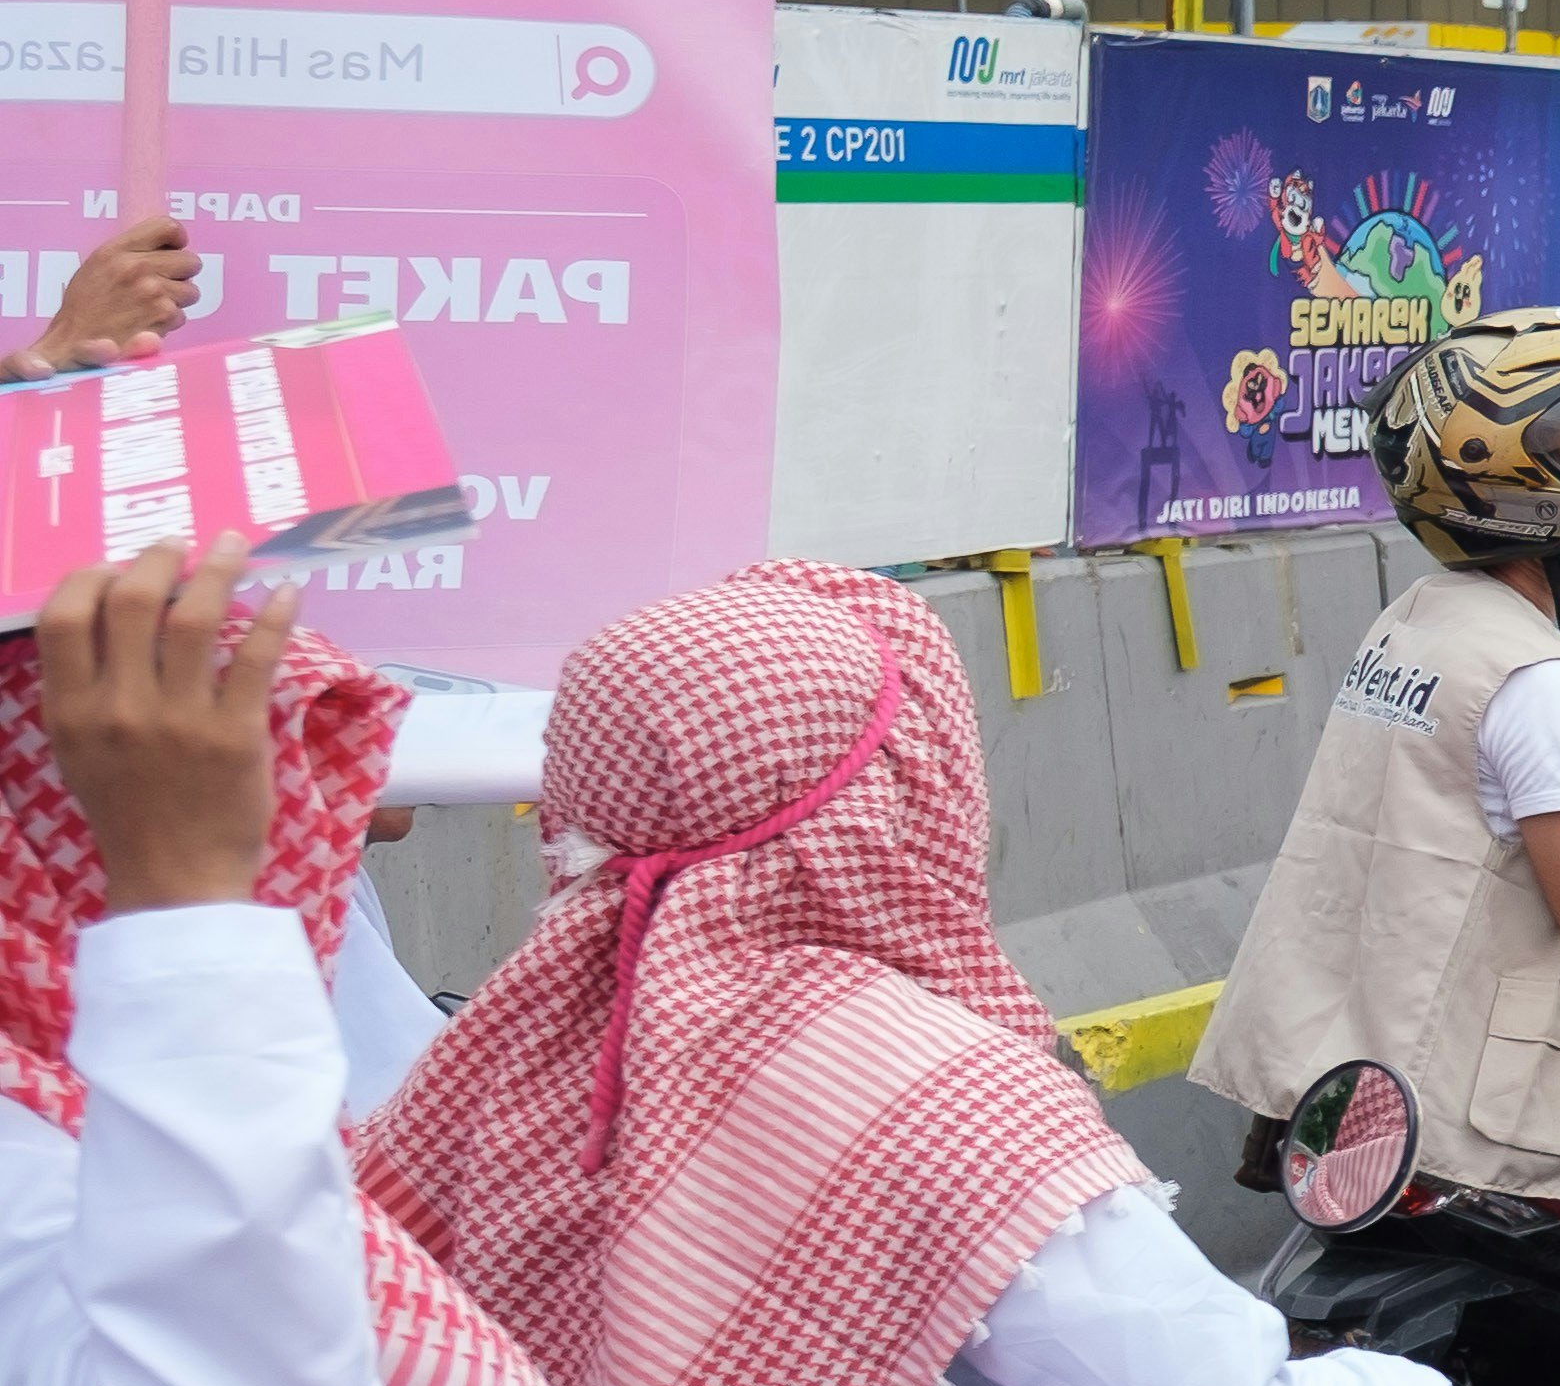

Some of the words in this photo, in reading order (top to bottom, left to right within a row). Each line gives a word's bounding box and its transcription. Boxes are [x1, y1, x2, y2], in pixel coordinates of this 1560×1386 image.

[800, 125, 817, 162] 2
[825, 126, 906, 164] CP201
[1289, 296, 1431, 348] SEMARAK
[1156, 497, 1203, 525] JATI
[1208, 493, 1251, 520] DIRI
[1255, 485, 1361, 517] INDONESIA
